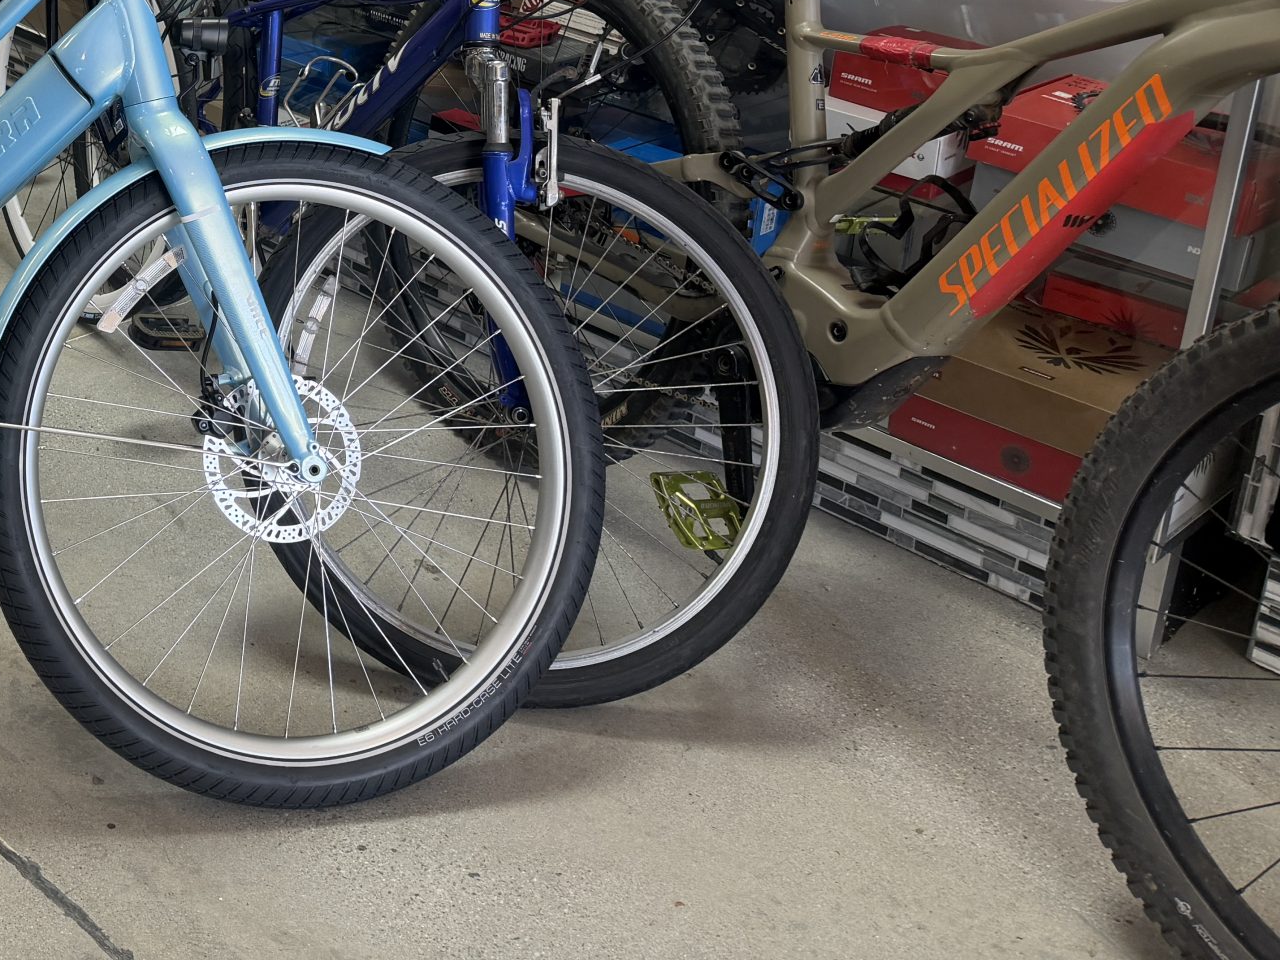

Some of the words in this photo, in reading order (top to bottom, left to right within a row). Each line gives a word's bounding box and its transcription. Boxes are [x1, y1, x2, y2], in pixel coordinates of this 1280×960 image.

[841, 72, 873, 85] SRAM
[987, 137, 1024, 152] SRAM
[938, 73, 1173, 317] SPECIALIZED
[417, 732, 435, 746] E6
[439, 678, 502, 736] HARD-CASE
[500, 653, 523, 680] LITE
